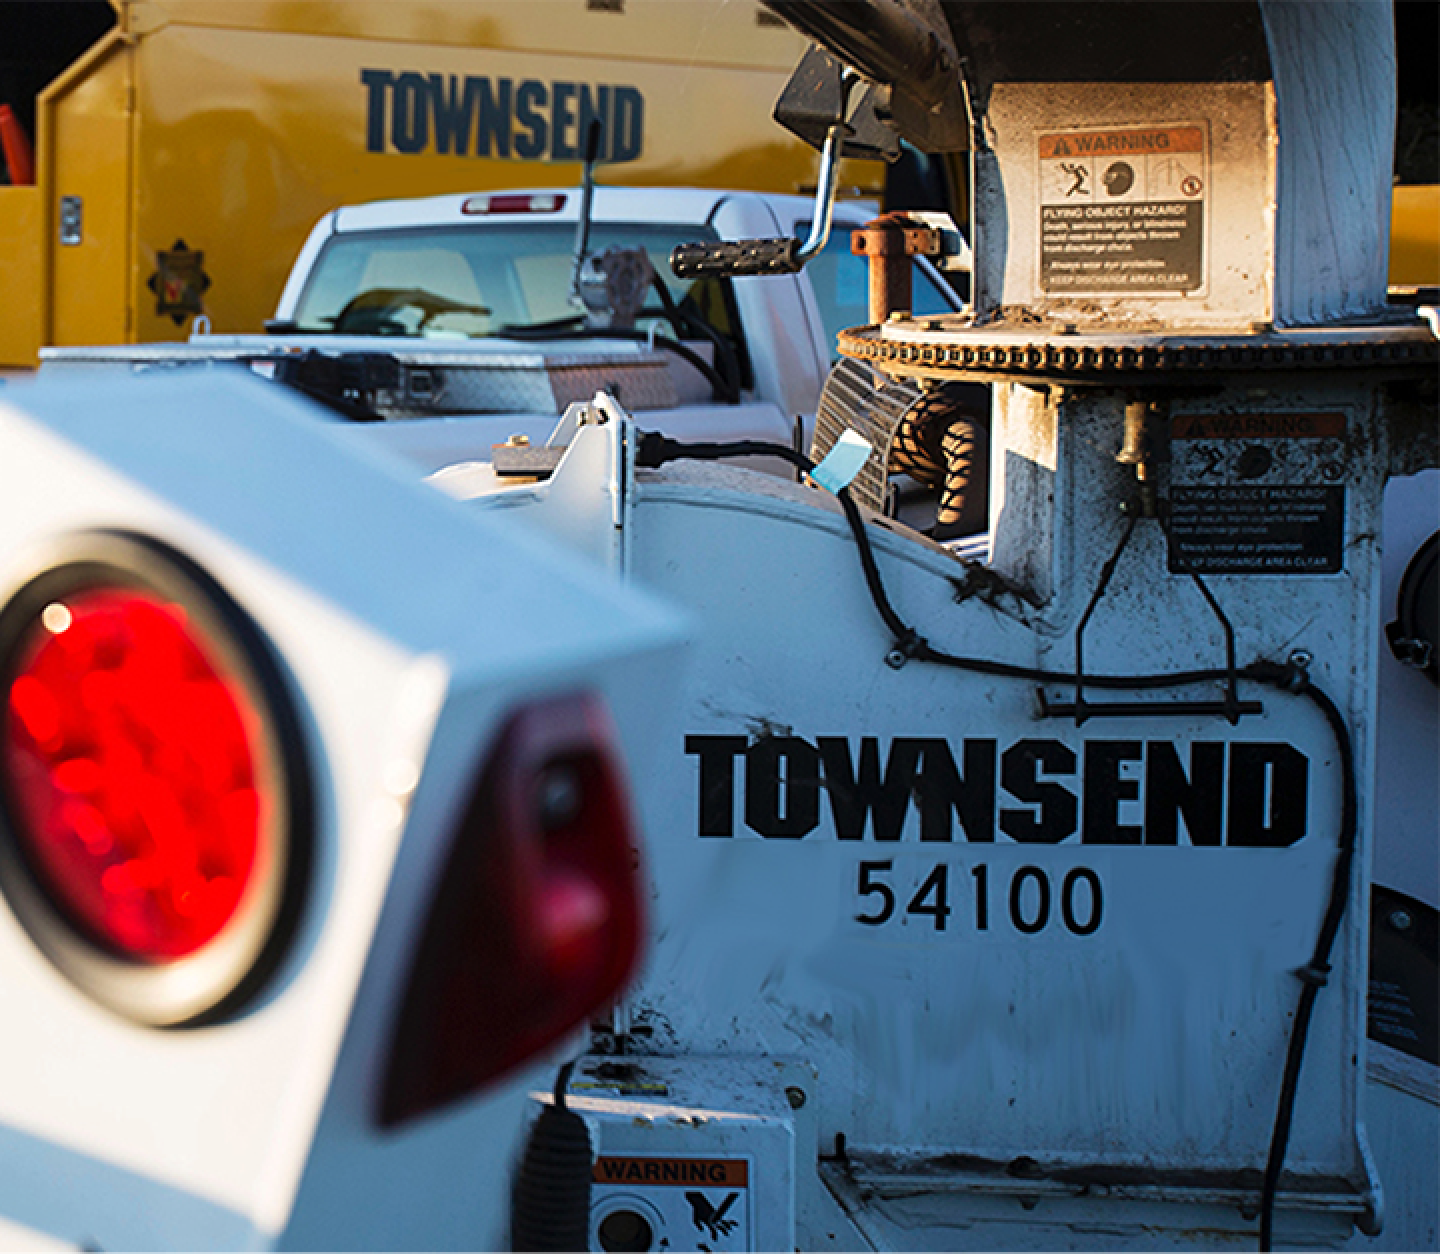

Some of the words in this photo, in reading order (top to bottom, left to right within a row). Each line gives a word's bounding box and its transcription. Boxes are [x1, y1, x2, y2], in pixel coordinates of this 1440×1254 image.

[360, 68, 644, 164] TOWNSEND
[1074, 133, 1171, 151] WARNING
[1043, 207, 1083, 219] FLYING
[1085, 205, 1131, 218] OBJECT
[1211, 417, 1312, 433] WARNING
[1180, 557, 1206, 568] KEP
[685, 734, 1310, 848] TOWNSEND
[854, 858, 1104, 937] 54100
[601, 1161, 727, 1183] WARNING
